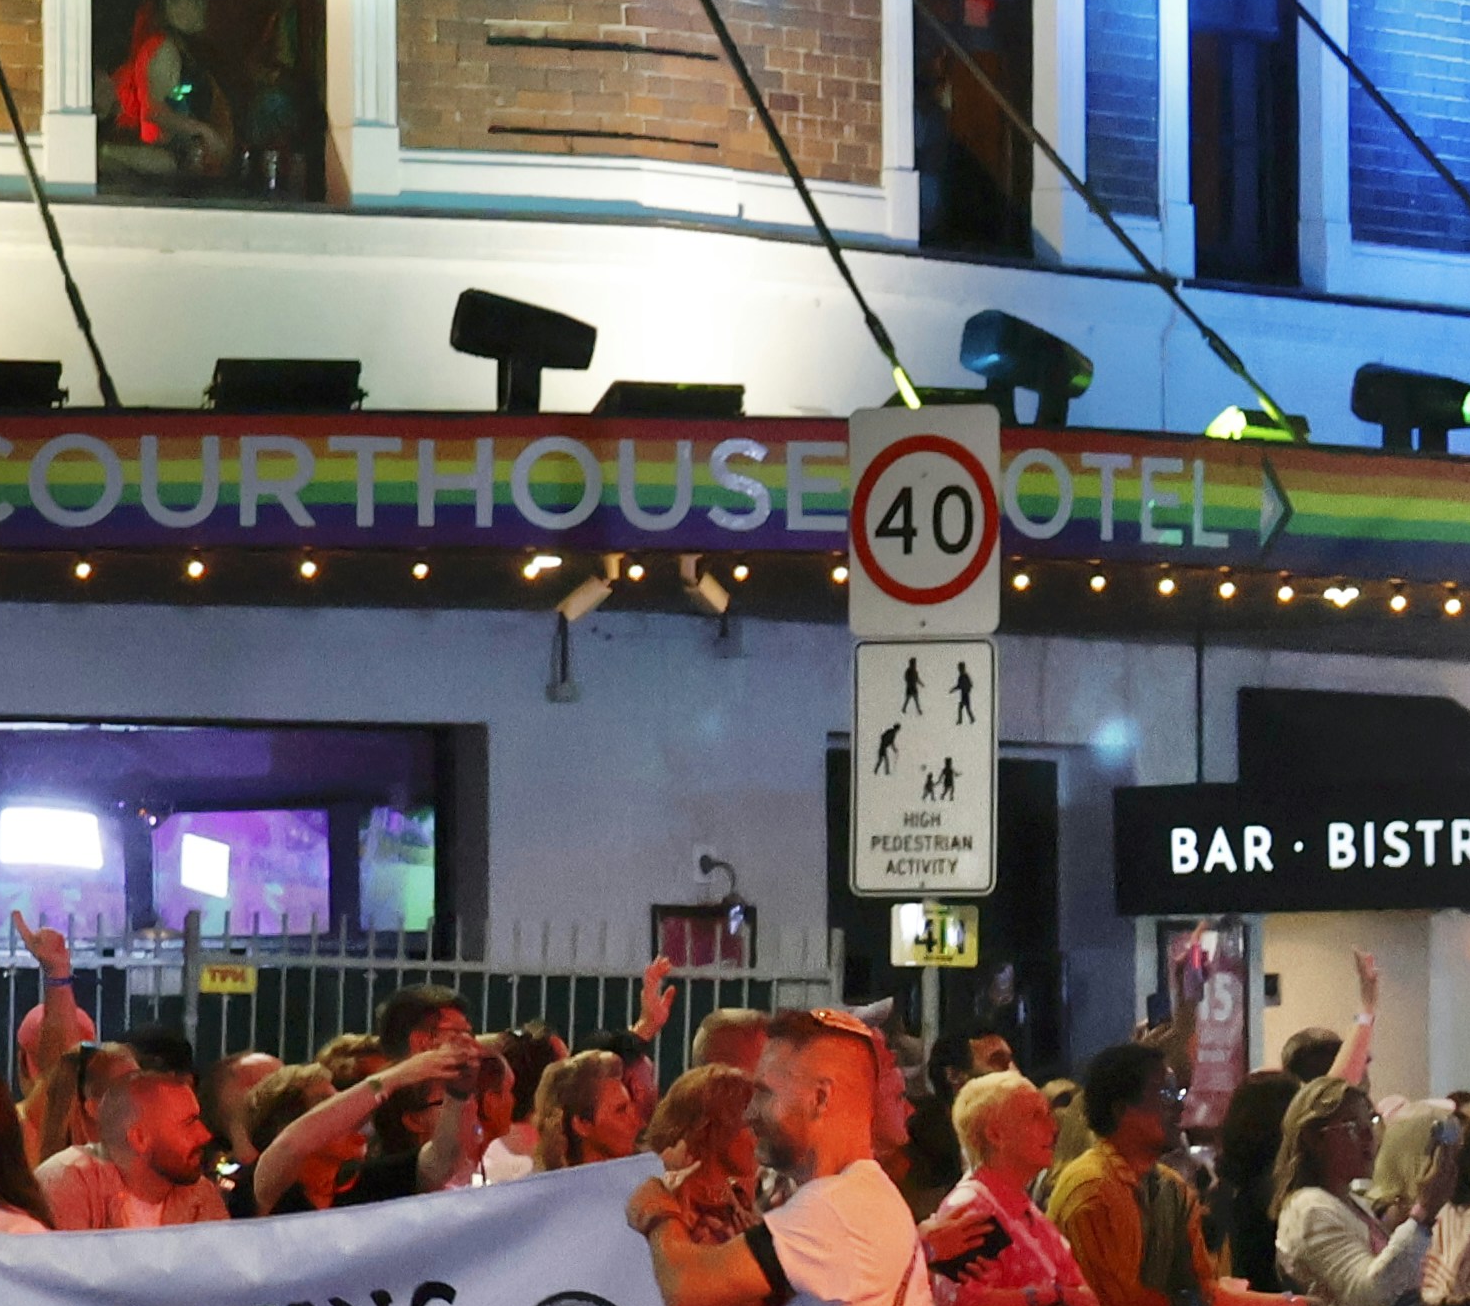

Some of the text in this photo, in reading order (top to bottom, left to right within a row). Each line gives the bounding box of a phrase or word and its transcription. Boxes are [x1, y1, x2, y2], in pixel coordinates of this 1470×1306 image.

[1003, 447, 1228, 550] OTEL
[874, 484, 973, 555] 40
[903, 812, 941, 828] HIGH
[870, 835, 973, 854] PEDESTRIAN
[1170, 826, 1274, 874] BAR
[885, 858, 958, 877] ACTIVITY
